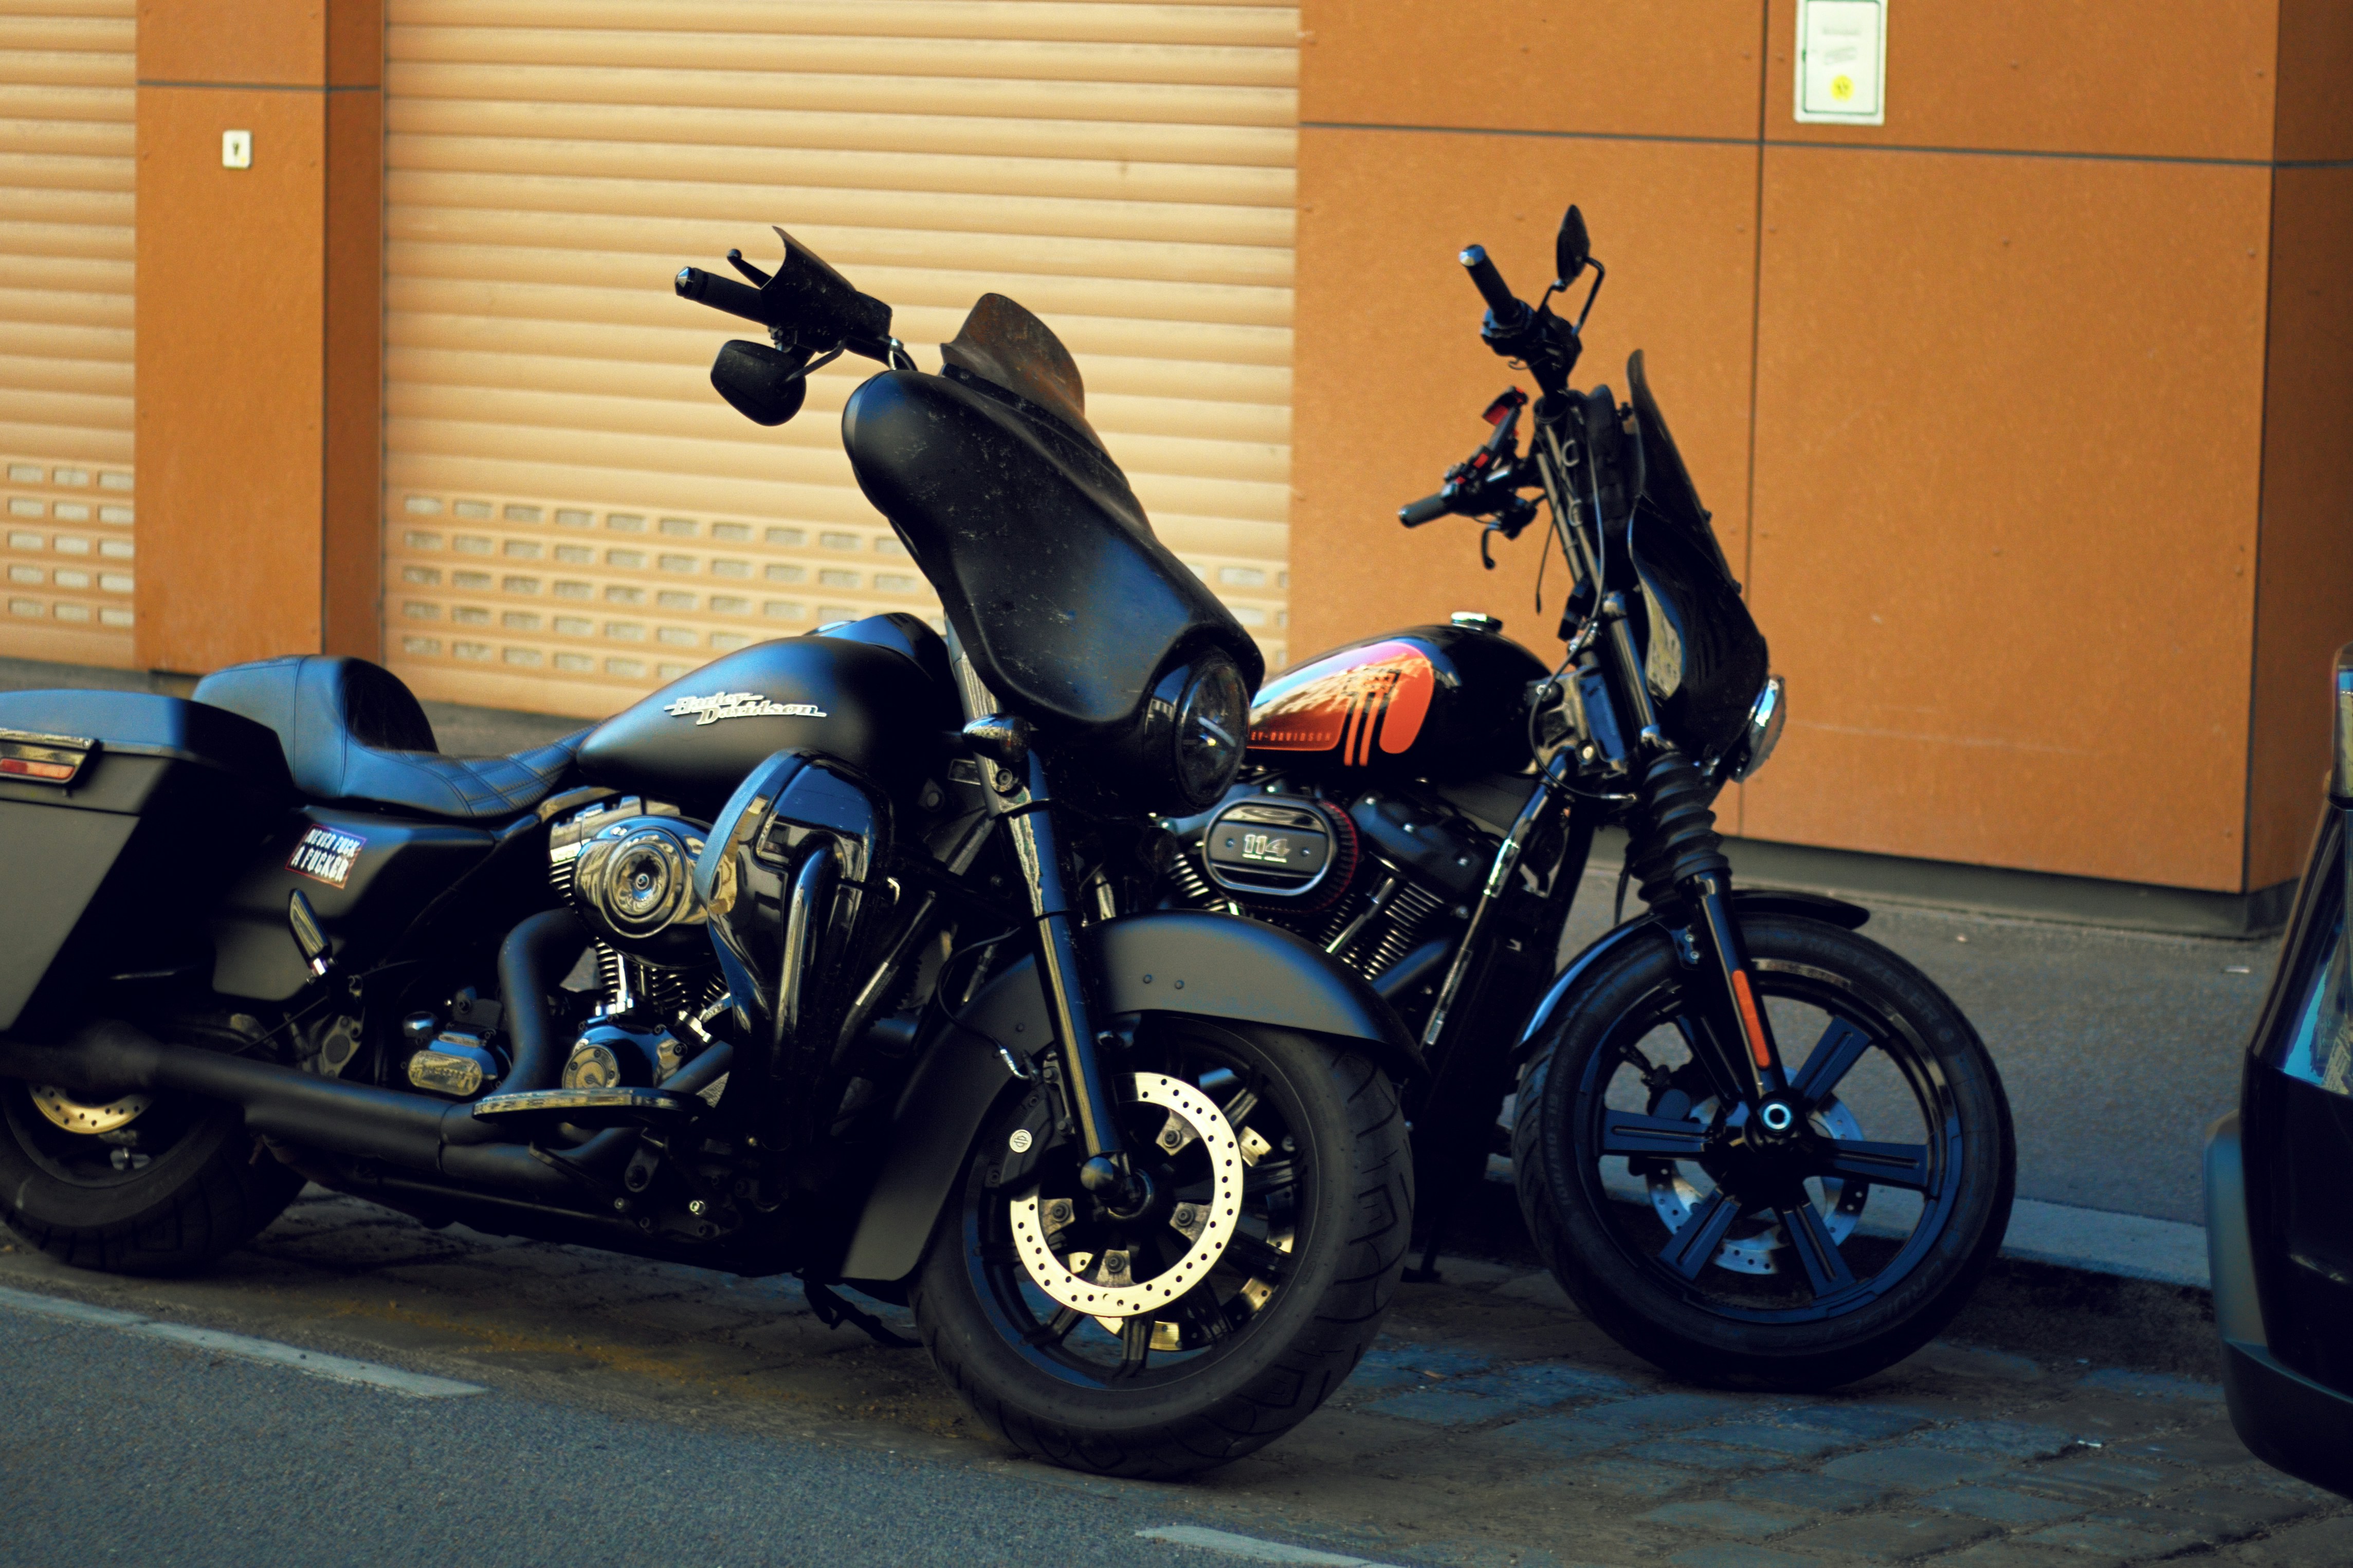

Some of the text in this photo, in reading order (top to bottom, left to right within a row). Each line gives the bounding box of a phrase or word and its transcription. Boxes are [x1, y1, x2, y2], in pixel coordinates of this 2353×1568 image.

[664, 692, 764, 716] Harley
[696, 700, 827, 725] Davidson
[1250, 731, 1331, 741] EY-DAVIDSON
[304, 828, 360, 858] NEVER FUCK
[1244, 834, 1290, 857] 114
[290, 845, 349, 882] A FUCKER
